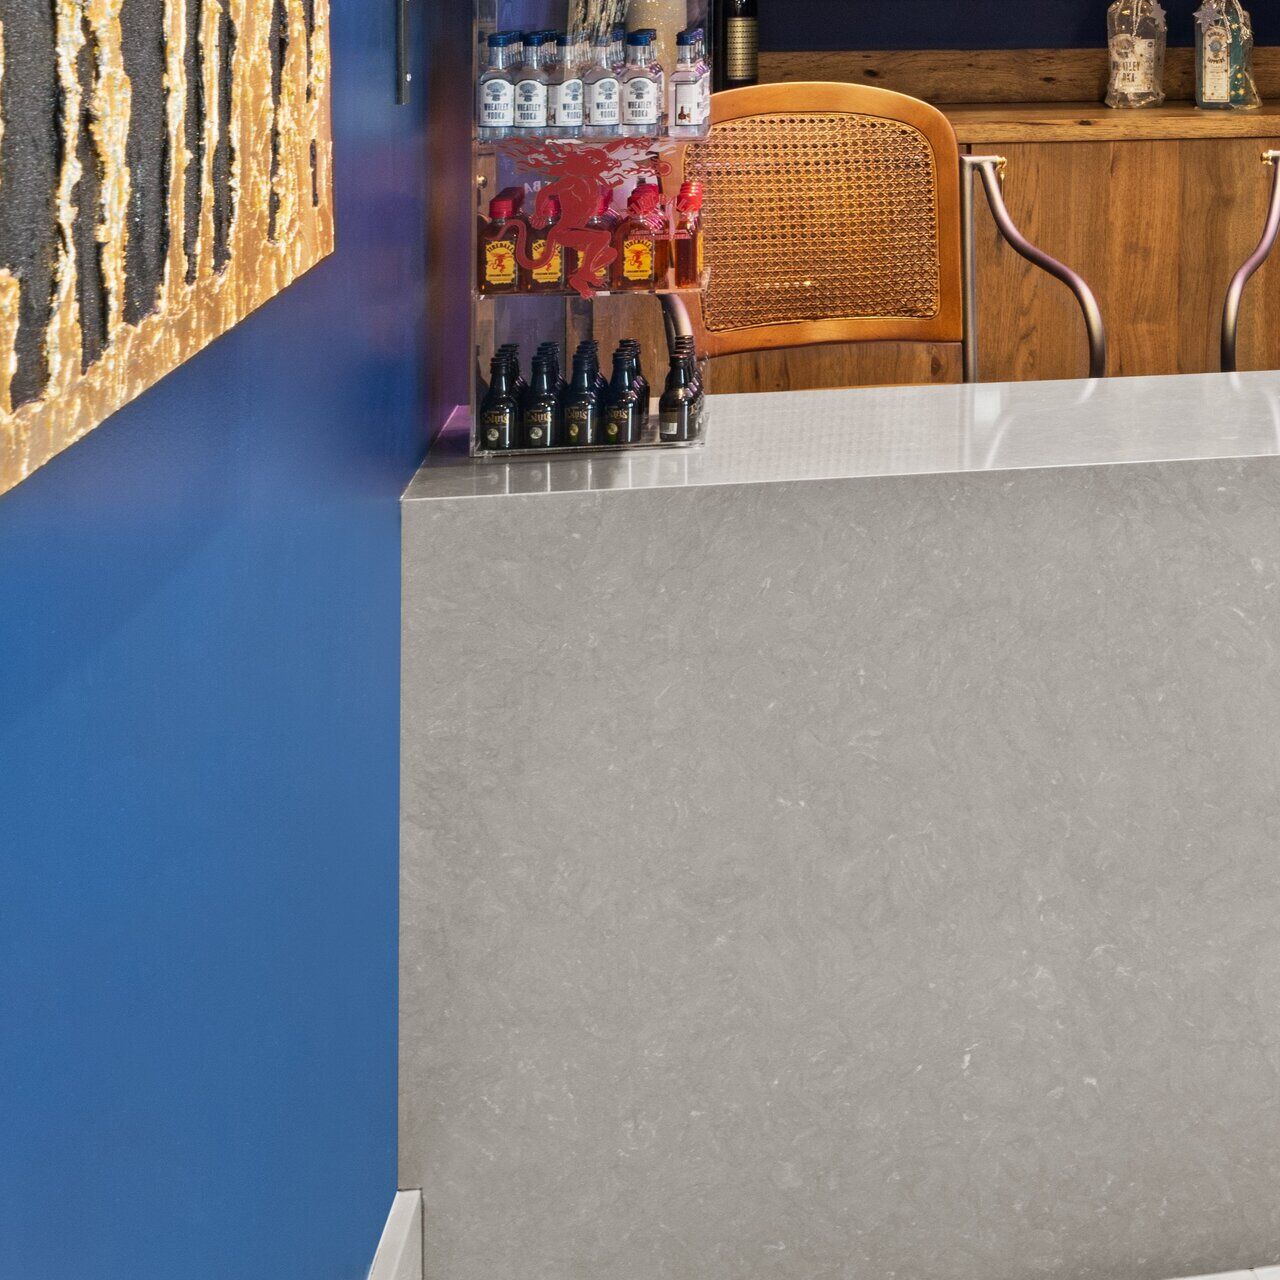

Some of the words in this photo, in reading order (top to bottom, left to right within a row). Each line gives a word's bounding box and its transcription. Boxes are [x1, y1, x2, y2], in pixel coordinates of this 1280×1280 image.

[484, 103, 509, 111] WHEATLEY
[517, 103, 541, 111] WHEATLEY
[627, 101, 652, 109] WHEATLEY
